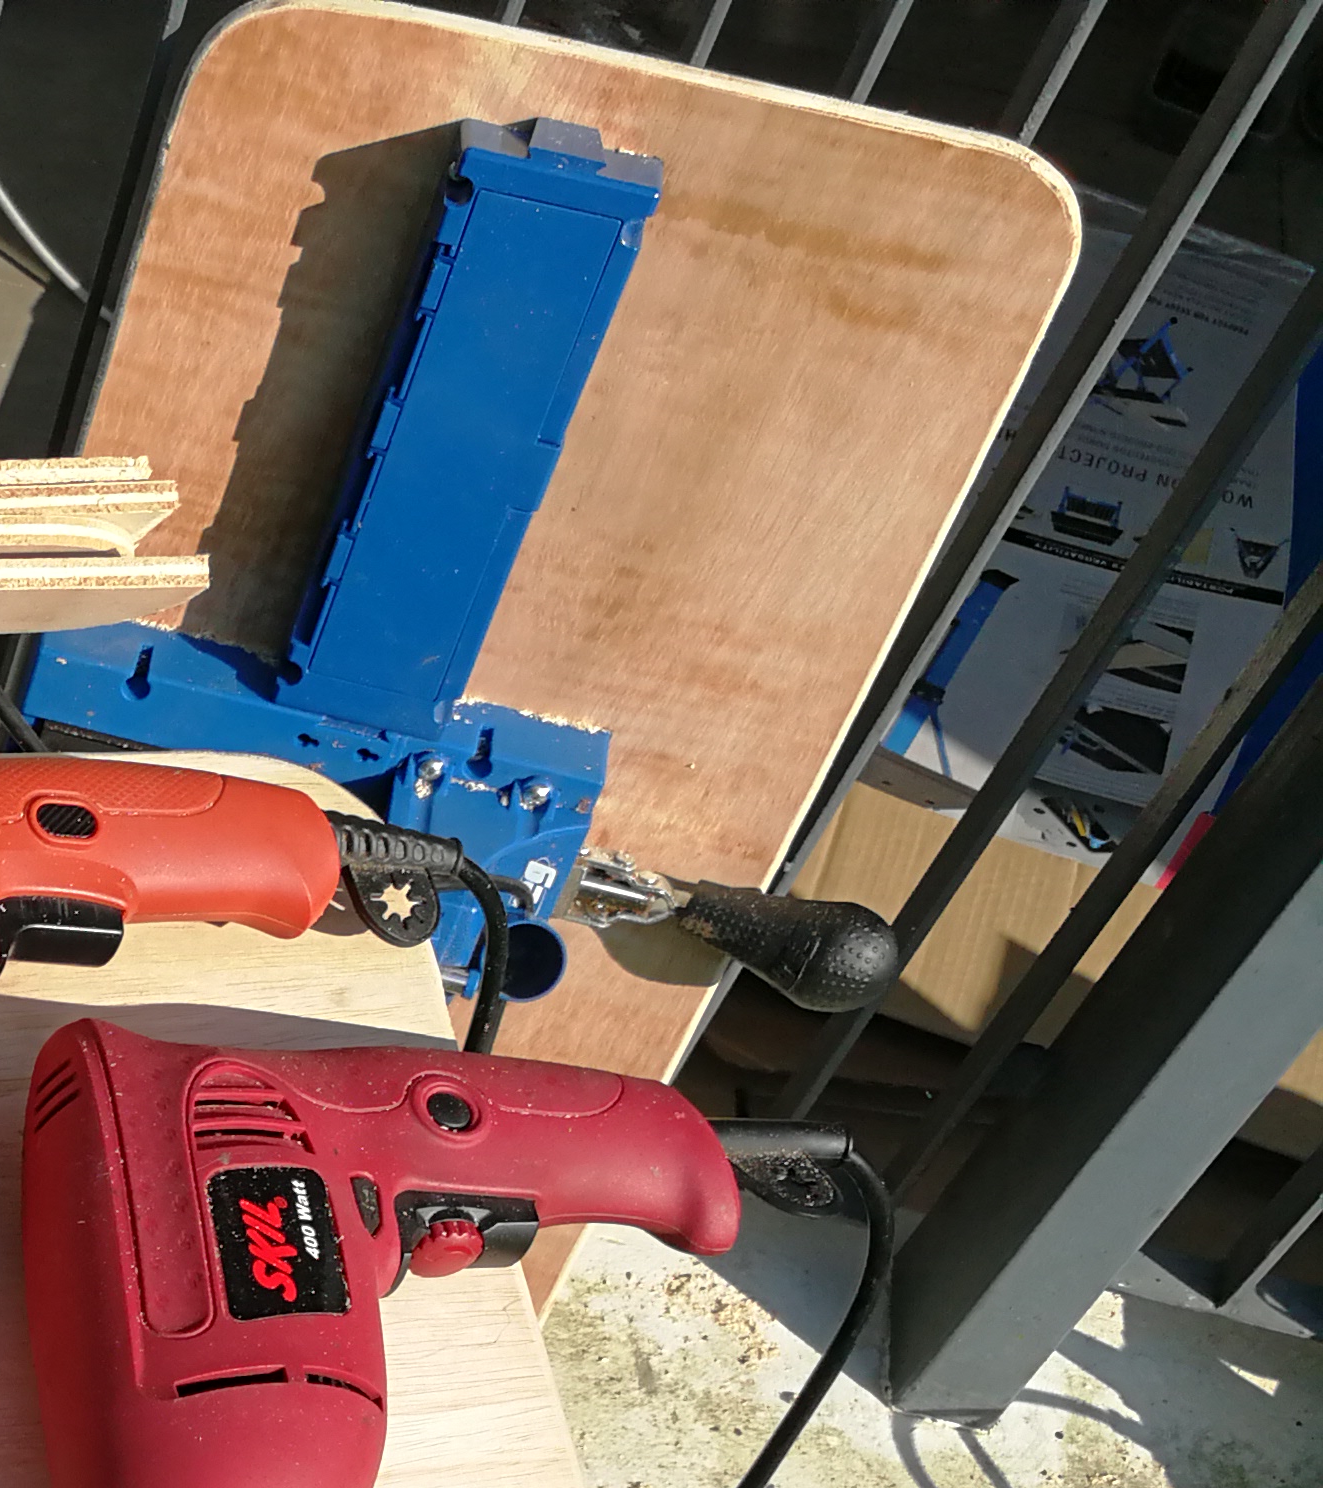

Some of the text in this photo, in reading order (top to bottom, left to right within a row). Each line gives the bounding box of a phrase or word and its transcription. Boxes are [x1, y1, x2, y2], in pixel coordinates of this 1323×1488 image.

[1056, 445, 1147, 482] PROJECT
[1169, 576, 1234, 594] PORTABILI
[291, 1179, 320, 1261] 400 Watt
[239, 1198, 298, 1302] SKIL
